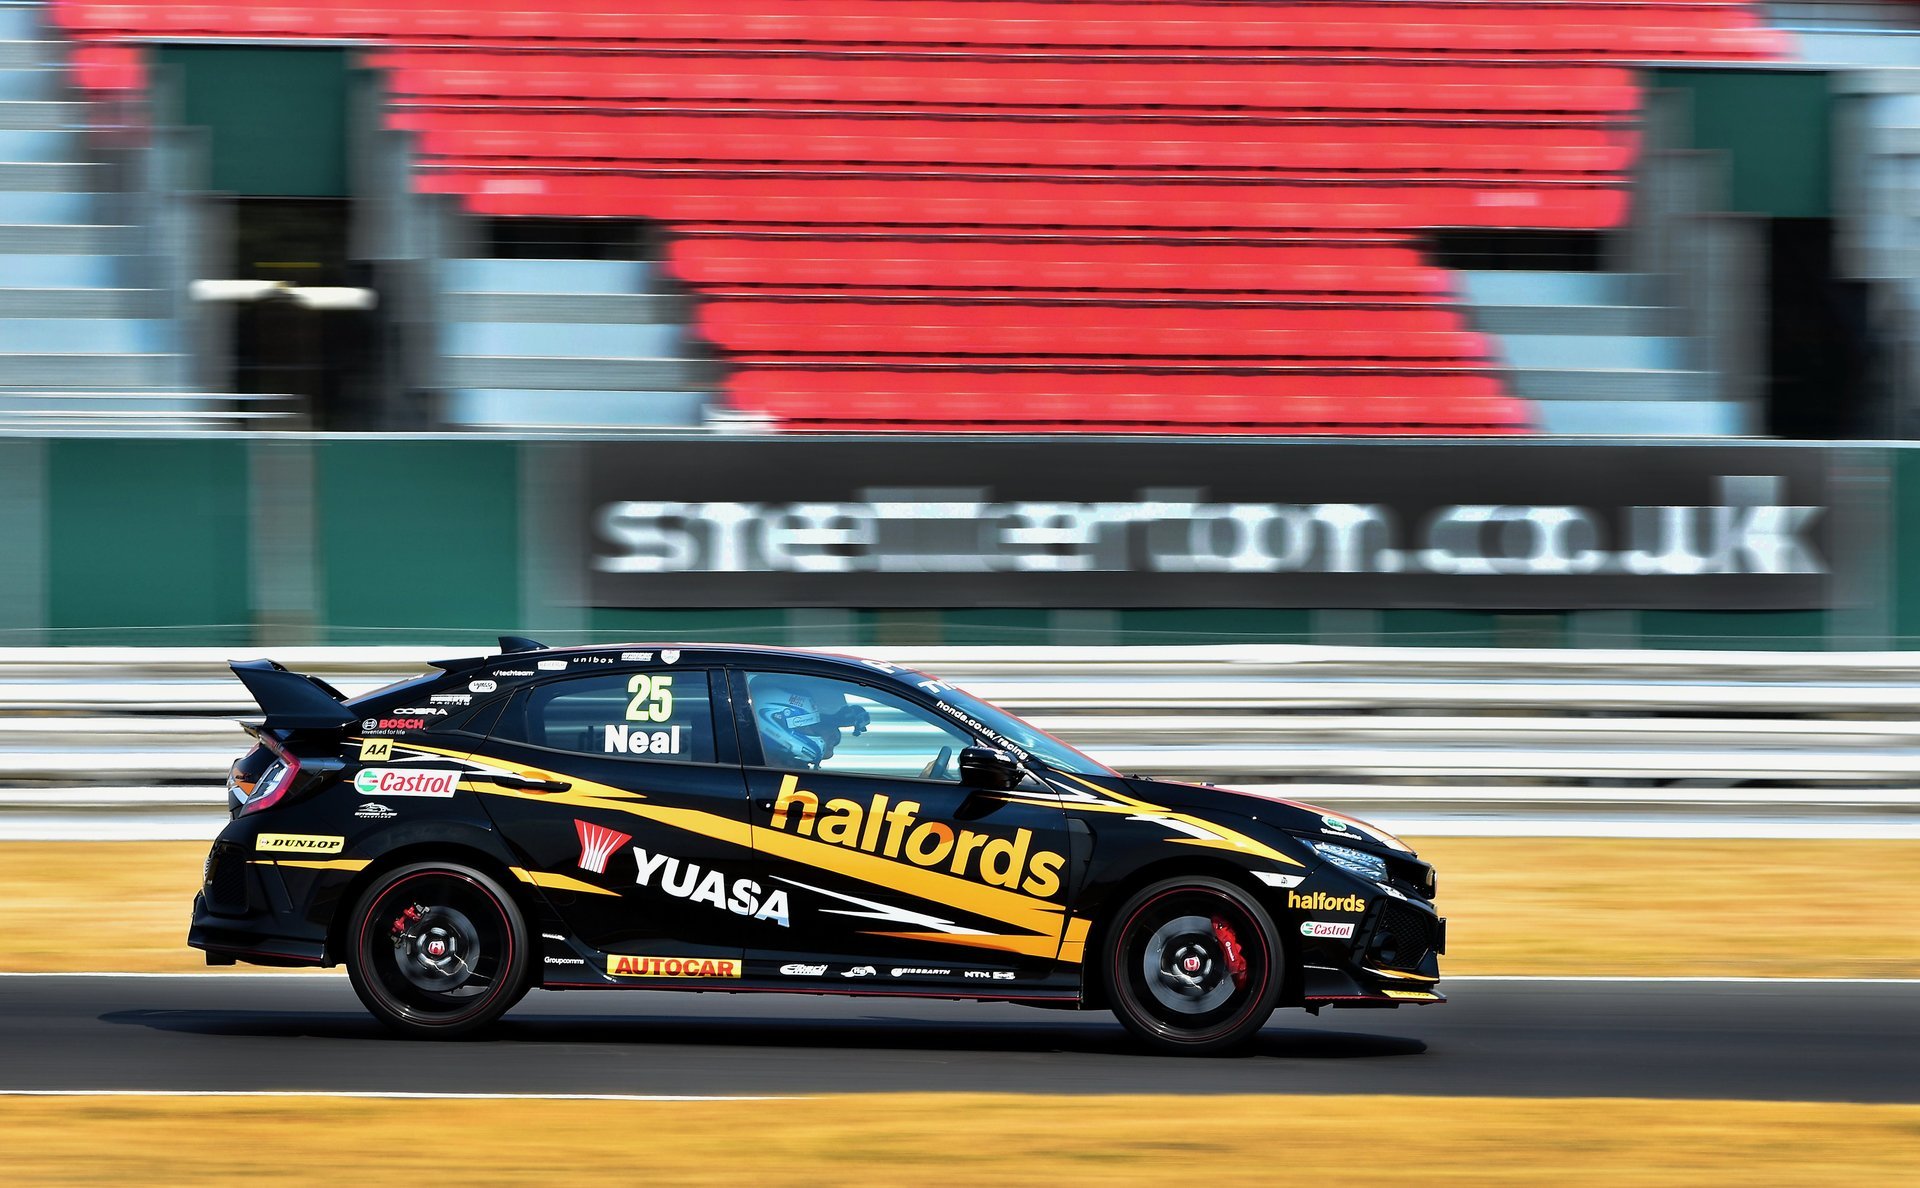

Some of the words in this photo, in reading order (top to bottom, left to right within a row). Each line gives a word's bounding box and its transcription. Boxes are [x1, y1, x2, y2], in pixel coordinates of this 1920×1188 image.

[573, 656, 614, 664] unibox
[625, 674, 673, 722] 25
[393, 707, 449, 716] COBRA
[378, 718, 424, 729] BOSCH
[936, 700, 1029, 760] honda.co.uk/racing
[365, 744, 388, 755] AA
[604, 724, 681, 755] Neal
[380, 771, 453, 793] Castrol
[272, 837, 341, 849] DUNLOP
[769, 775, 1066, 897] halfords
[632, 846, 791, 928] YUASA
[1288, 890, 1366, 912] halfords
[1314, 924, 1350, 936] Castrol
[544, 956, 585, 965] Groupcomms
[615, 956, 735, 978] AUTOCAR
